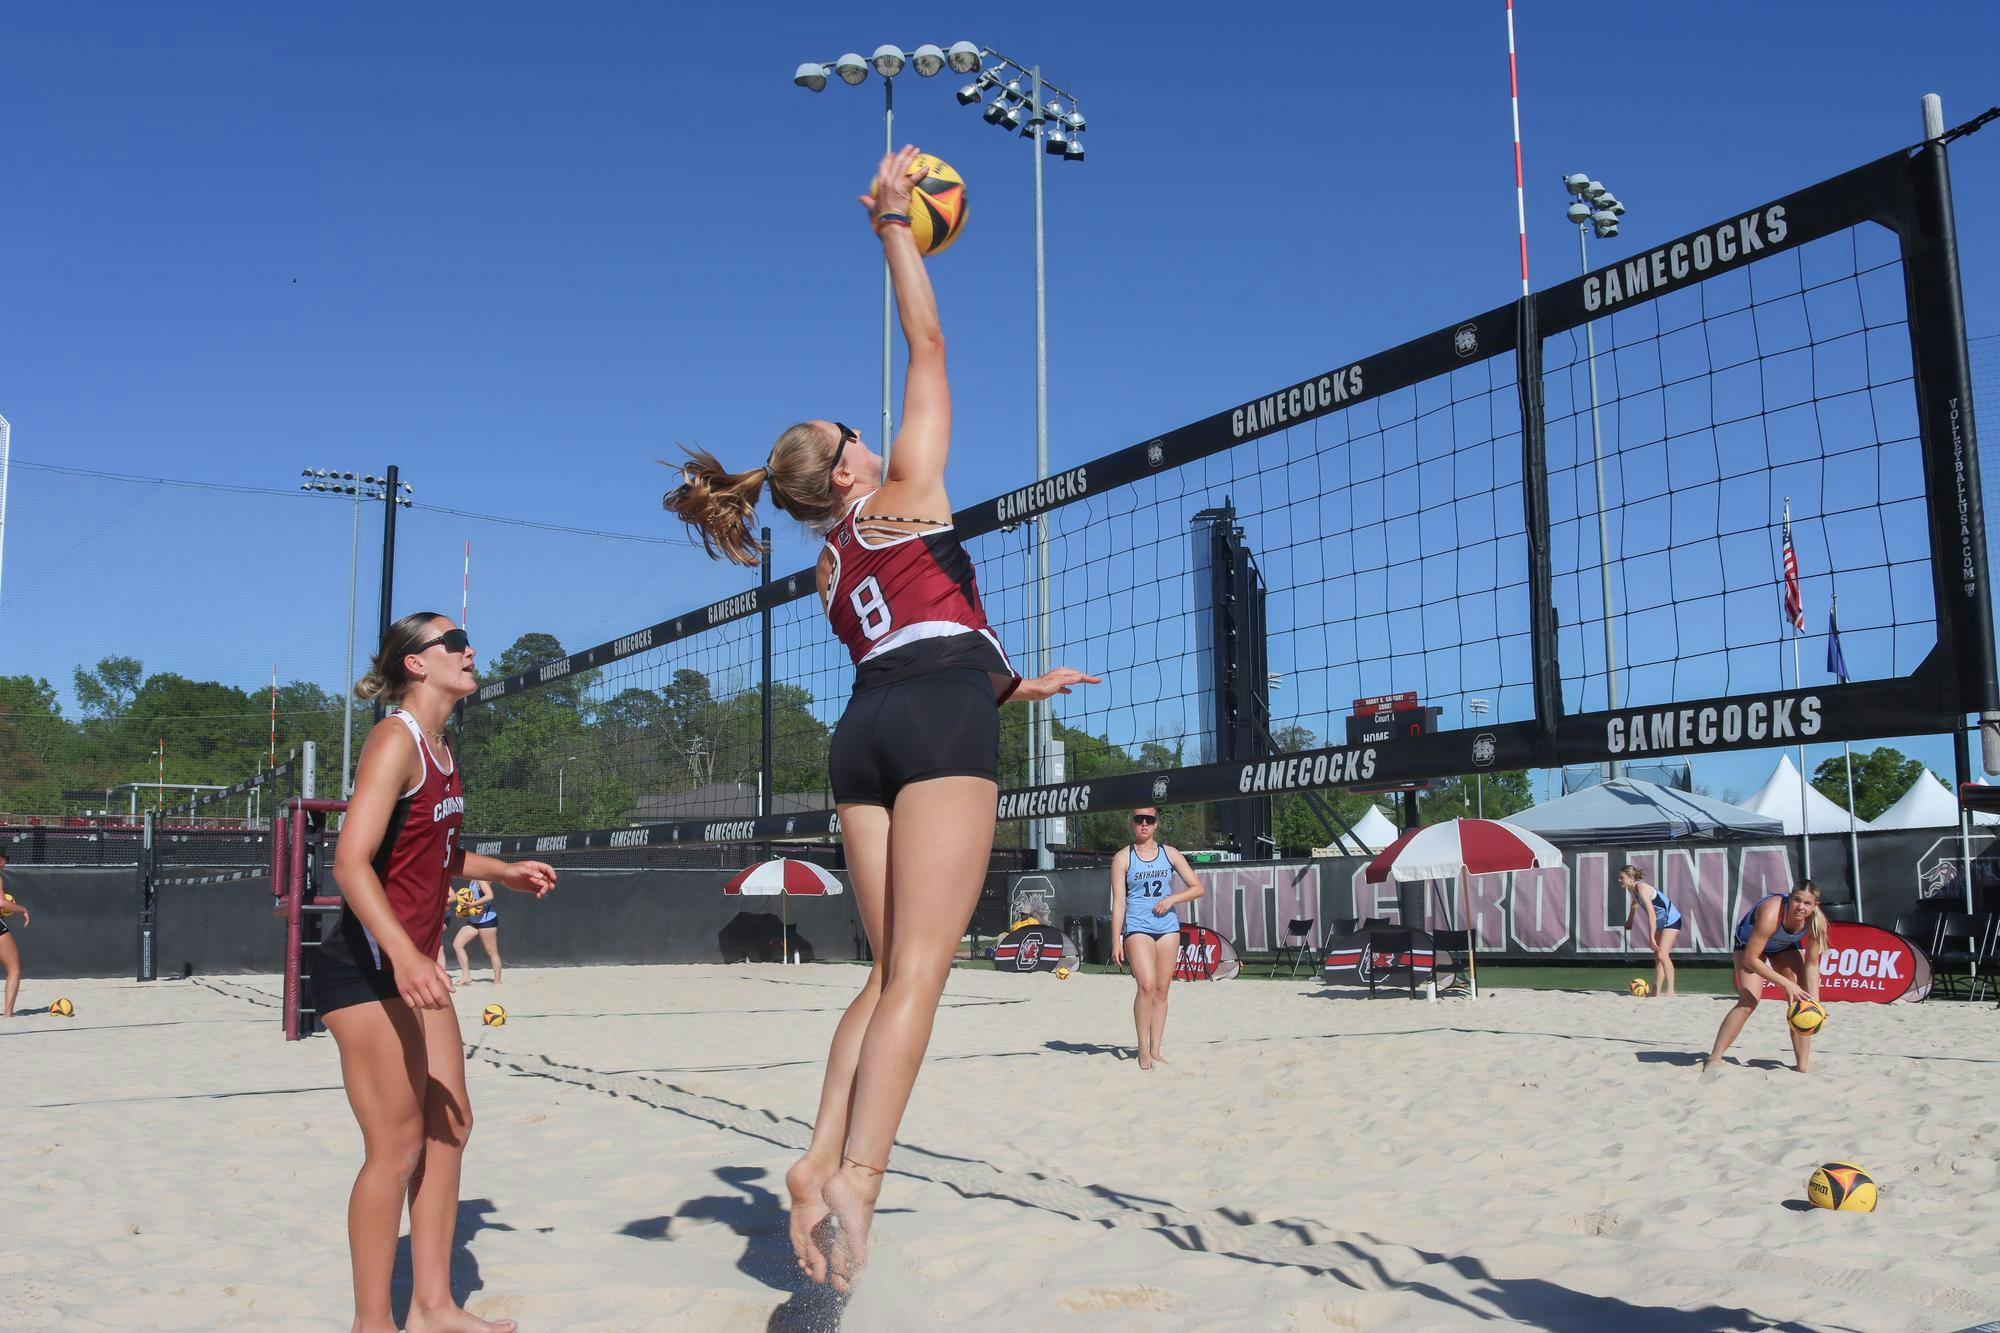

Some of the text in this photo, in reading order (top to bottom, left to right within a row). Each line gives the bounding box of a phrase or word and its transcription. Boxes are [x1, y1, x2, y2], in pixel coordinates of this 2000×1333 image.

[1583, 203, 1789, 312] GAMECOCKS
[1232, 365, 1364, 438] GAMECOCKS
[996, 467, 1087, 522] GAMECOCKS
[708, 590, 757, 624] GAMECOCKS
[850, 575, 892, 641] 8
[614, 629, 652, 657] GAMECOCKS
[539, 658, 570, 682] GAMECOCKS
[480, 680, 505, 701] GAMECOCKS
[1374, 712, 1390, 723] Court
[1607, 695, 1822, 753] GAMECOCKS
[1363, 731, 1390, 743] HOME
[1239, 748, 1377, 793] GAMECOCKS
[997, 784, 1091, 818] GAMECOCKS
[536, 835, 567, 851] GAMECOCKS
[610, 828, 649, 848] GAMECOCKS
[703, 820, 755, 842] GAMECOCKS
[442, 827, 455, 868] 5
[1133, 869, 1168, 881] SKYHAWKS
[1142, 880, 1163, 898] 12
[1812, 948, 1902, 979] COCK
